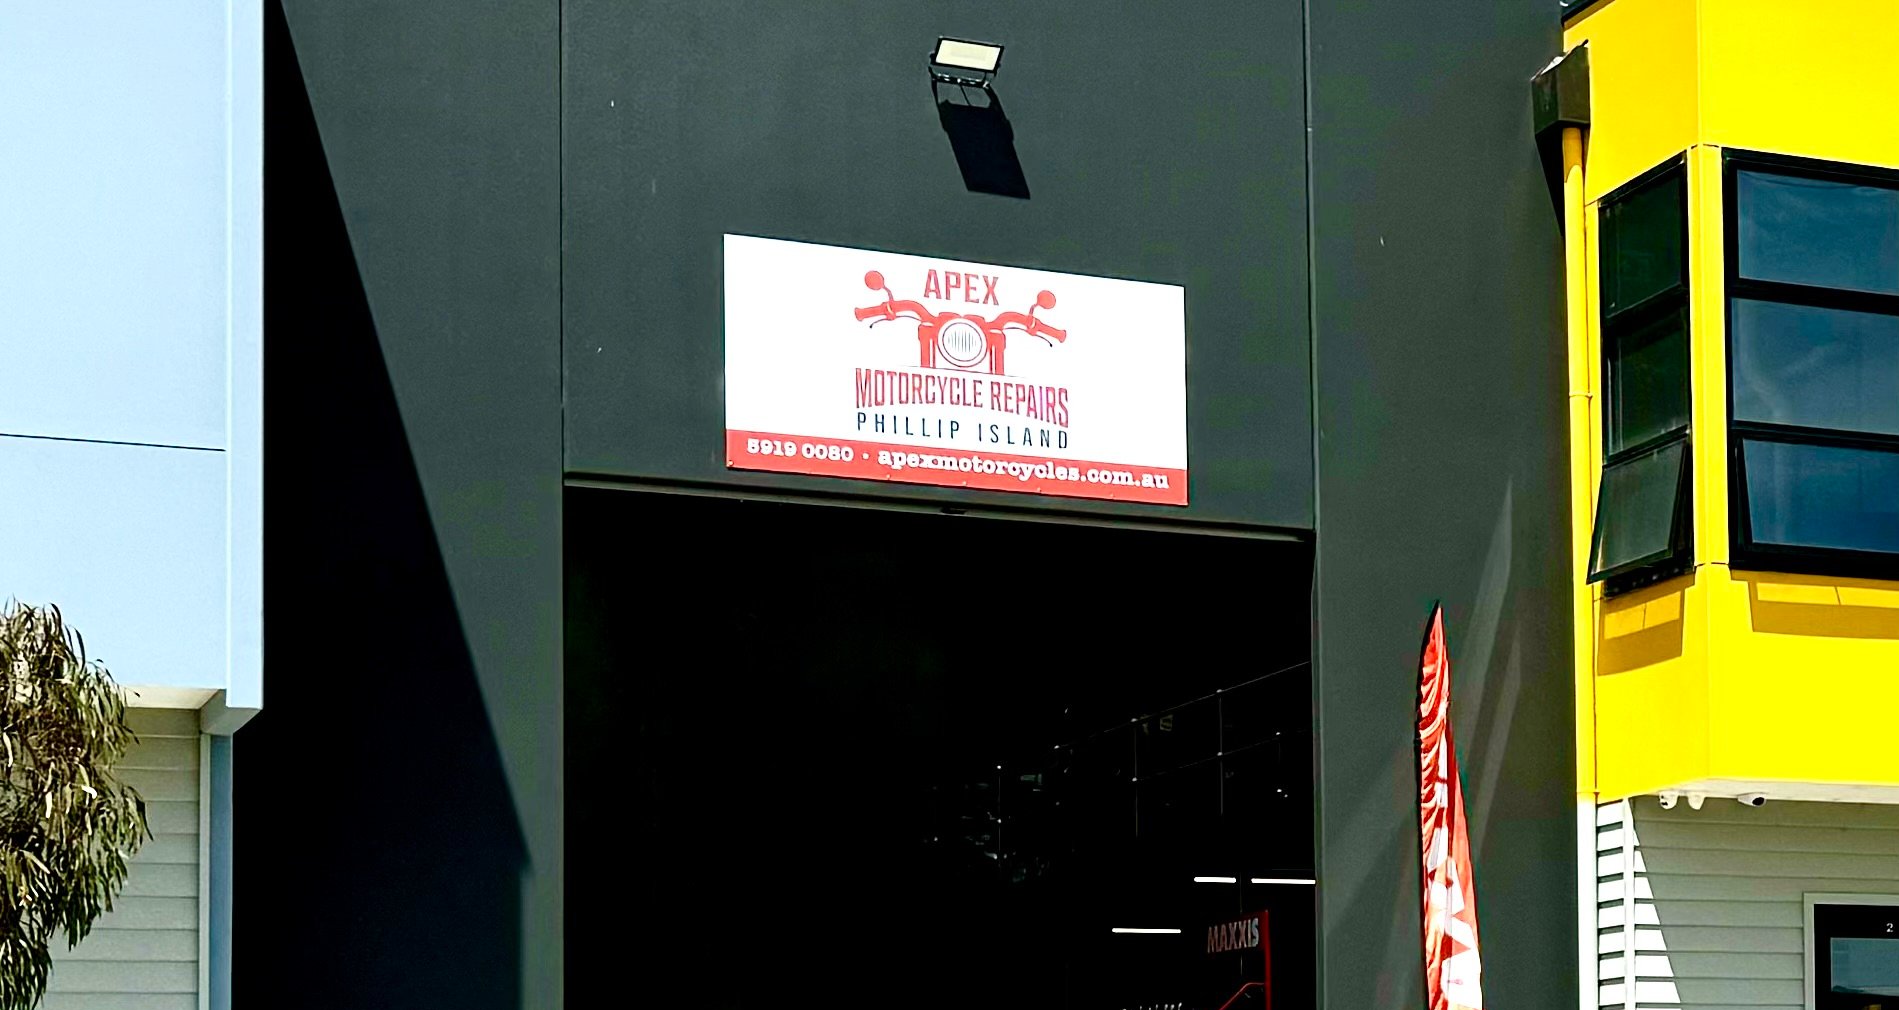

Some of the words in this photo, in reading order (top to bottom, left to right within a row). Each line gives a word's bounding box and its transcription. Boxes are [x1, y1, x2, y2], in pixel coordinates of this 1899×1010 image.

[923, 268, 1000, 306] APEX
[855, 367, 984, 409] MOTORCYCLE
[990, 380, 1069, 428] REPAIRS
[856, 411, 960, 440] PHILLIP
[977, 422, 1069, 449] ISLAND
[746, 437, 798, 457] 5919
[801, 442, 854, 462] 0080
[877, 449, 1169, 489] apexmotorcycles.com.au
[1207, 917, 1260, 953] MAXXIS
[1886, 922, 1894, 933] 2
